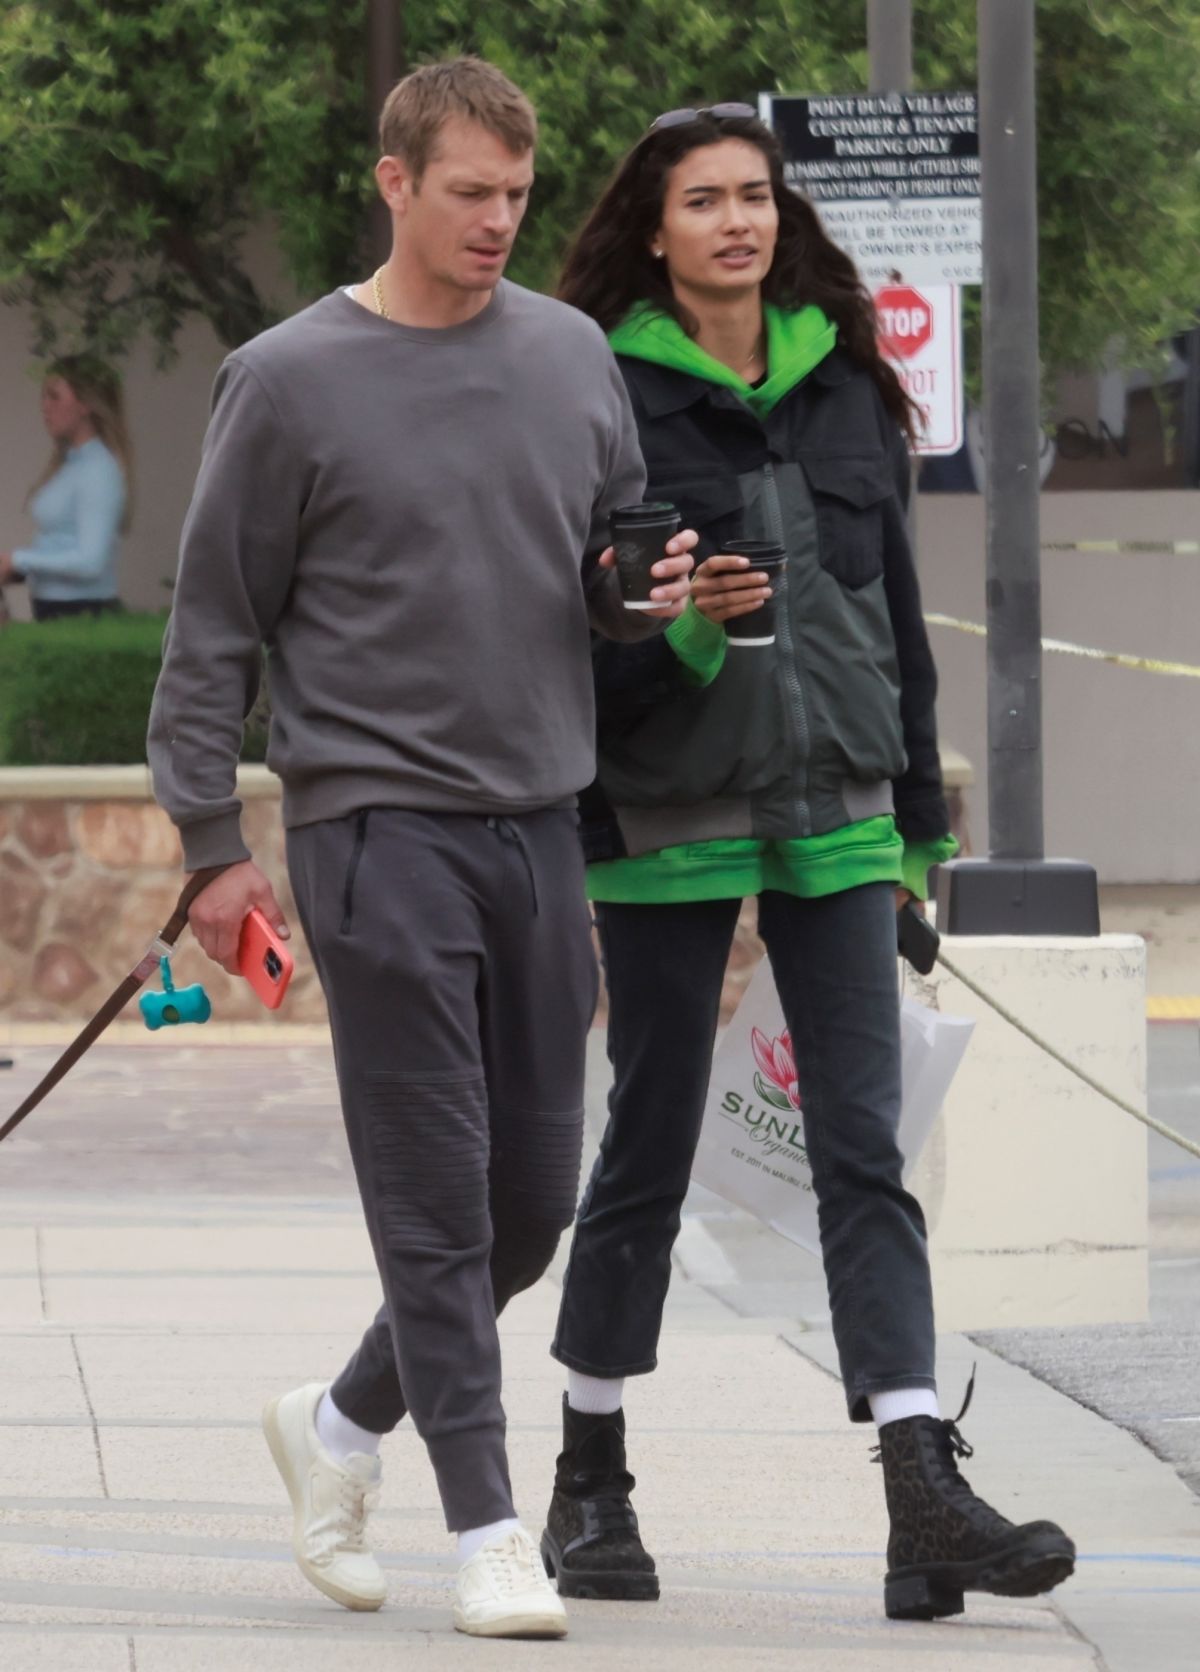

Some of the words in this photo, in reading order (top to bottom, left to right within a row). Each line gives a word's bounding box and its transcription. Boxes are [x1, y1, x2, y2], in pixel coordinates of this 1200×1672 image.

[808, 98, 855, 117] POINT
[906, 95, 976, 114] VILLAGE
[808, 117, 894, 137] CUSTOMER
[897, 117, 911, 135] &
[914, 115, 977, 133] TENANT
[834, 138, 904, 156] PARKING
[906, 137, 951, 154] ONLY
[796, 160, 842, 179] PARKING
[842, 161, 870, 178] ONLY
[870, 160, 907, 177] WHILE
[908, 158, 960, 176] ACTIVELY
[848, 180, 894, 197] PARKING
[895, 179, 909, 194] BY
[911, 178, 952, 194] PERMIT
[866, 226, 885, 240] BE
[890, 224, 945, 239] TOWED
[950, 223, 970, 238] AT
[858, 241, 930, 257] OWNER'S
[878, 307, 926, 337] TOP
[762, 1164, 771, 1174] IN
